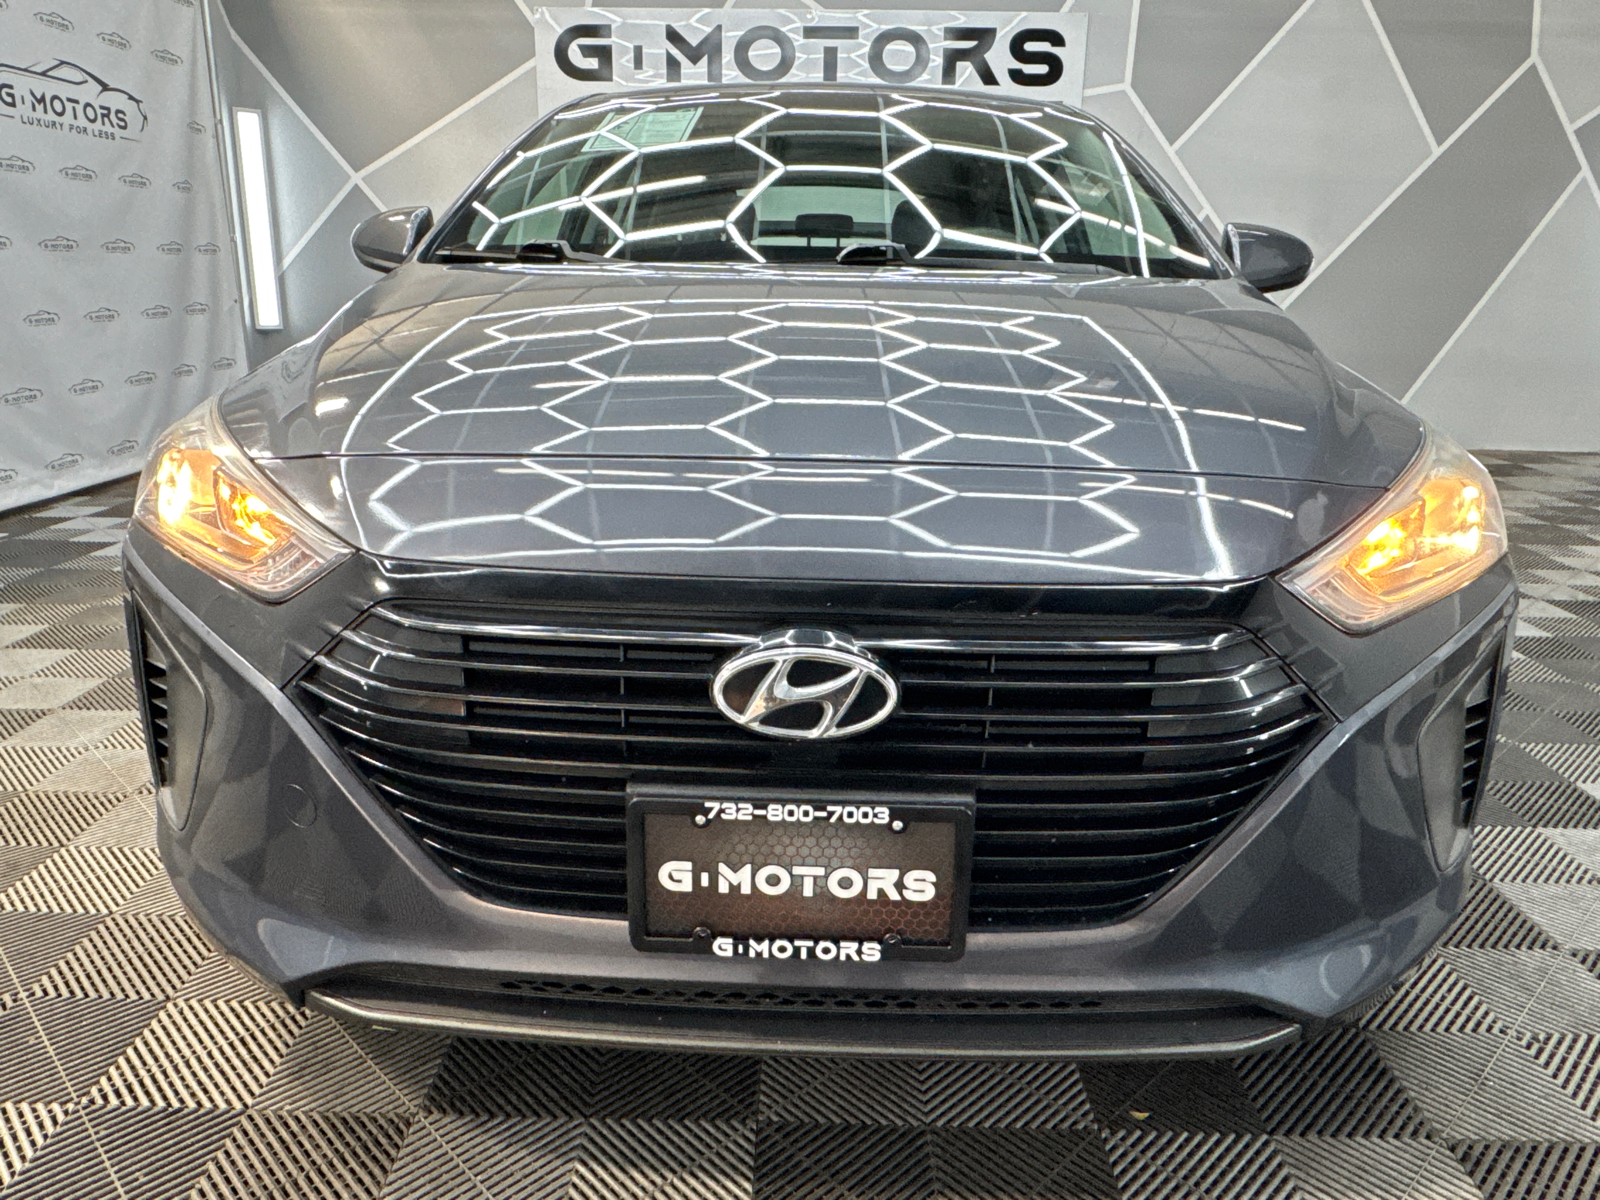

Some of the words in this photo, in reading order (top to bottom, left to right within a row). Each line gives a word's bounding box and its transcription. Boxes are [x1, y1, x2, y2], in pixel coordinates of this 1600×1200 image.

[20, 114, 64, 131] LUXURY
[68, 124, 89, 136] FOR
[92, 129, 116, 141] LESS
[703, 801, 891, 824] 732-800-7003
